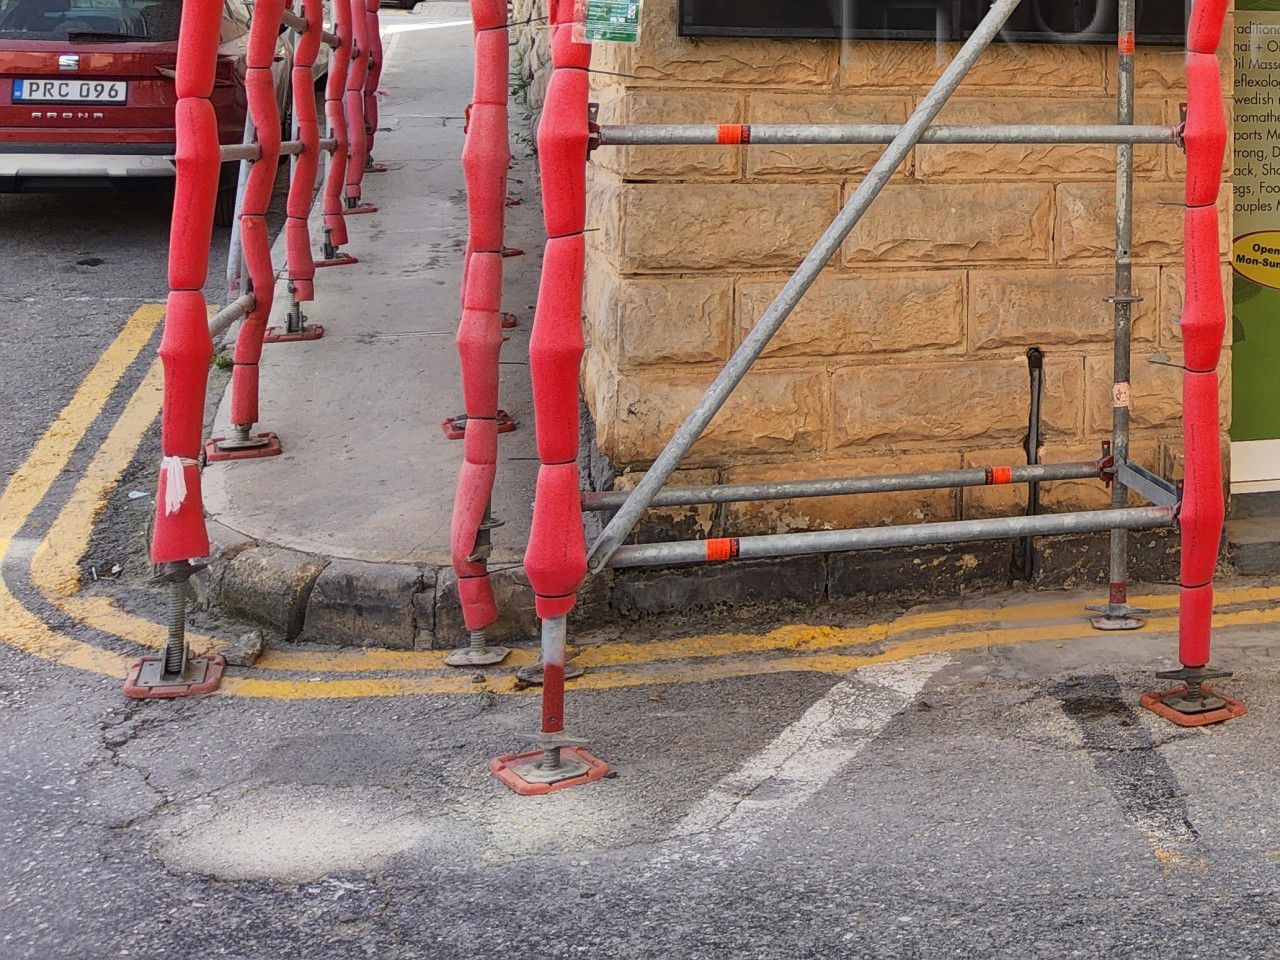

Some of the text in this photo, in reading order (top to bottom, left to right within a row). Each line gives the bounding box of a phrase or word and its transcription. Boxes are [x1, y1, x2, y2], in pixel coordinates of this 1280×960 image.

[1234, 40, 1251, 53] hai
[1234, 57, 1245, 69] il
[28, 82, 119, 98] PRC 096
[1234, 91, 1273, 105] wedish
[1234, 130, 1262, 143] ports
[1234, 148, 1268, 161] trong,
[1234, 164, 1258, 178] ack,
[1233, 185, 1255, 197] egs,
[1234, 198, 1272, 215] ouples
